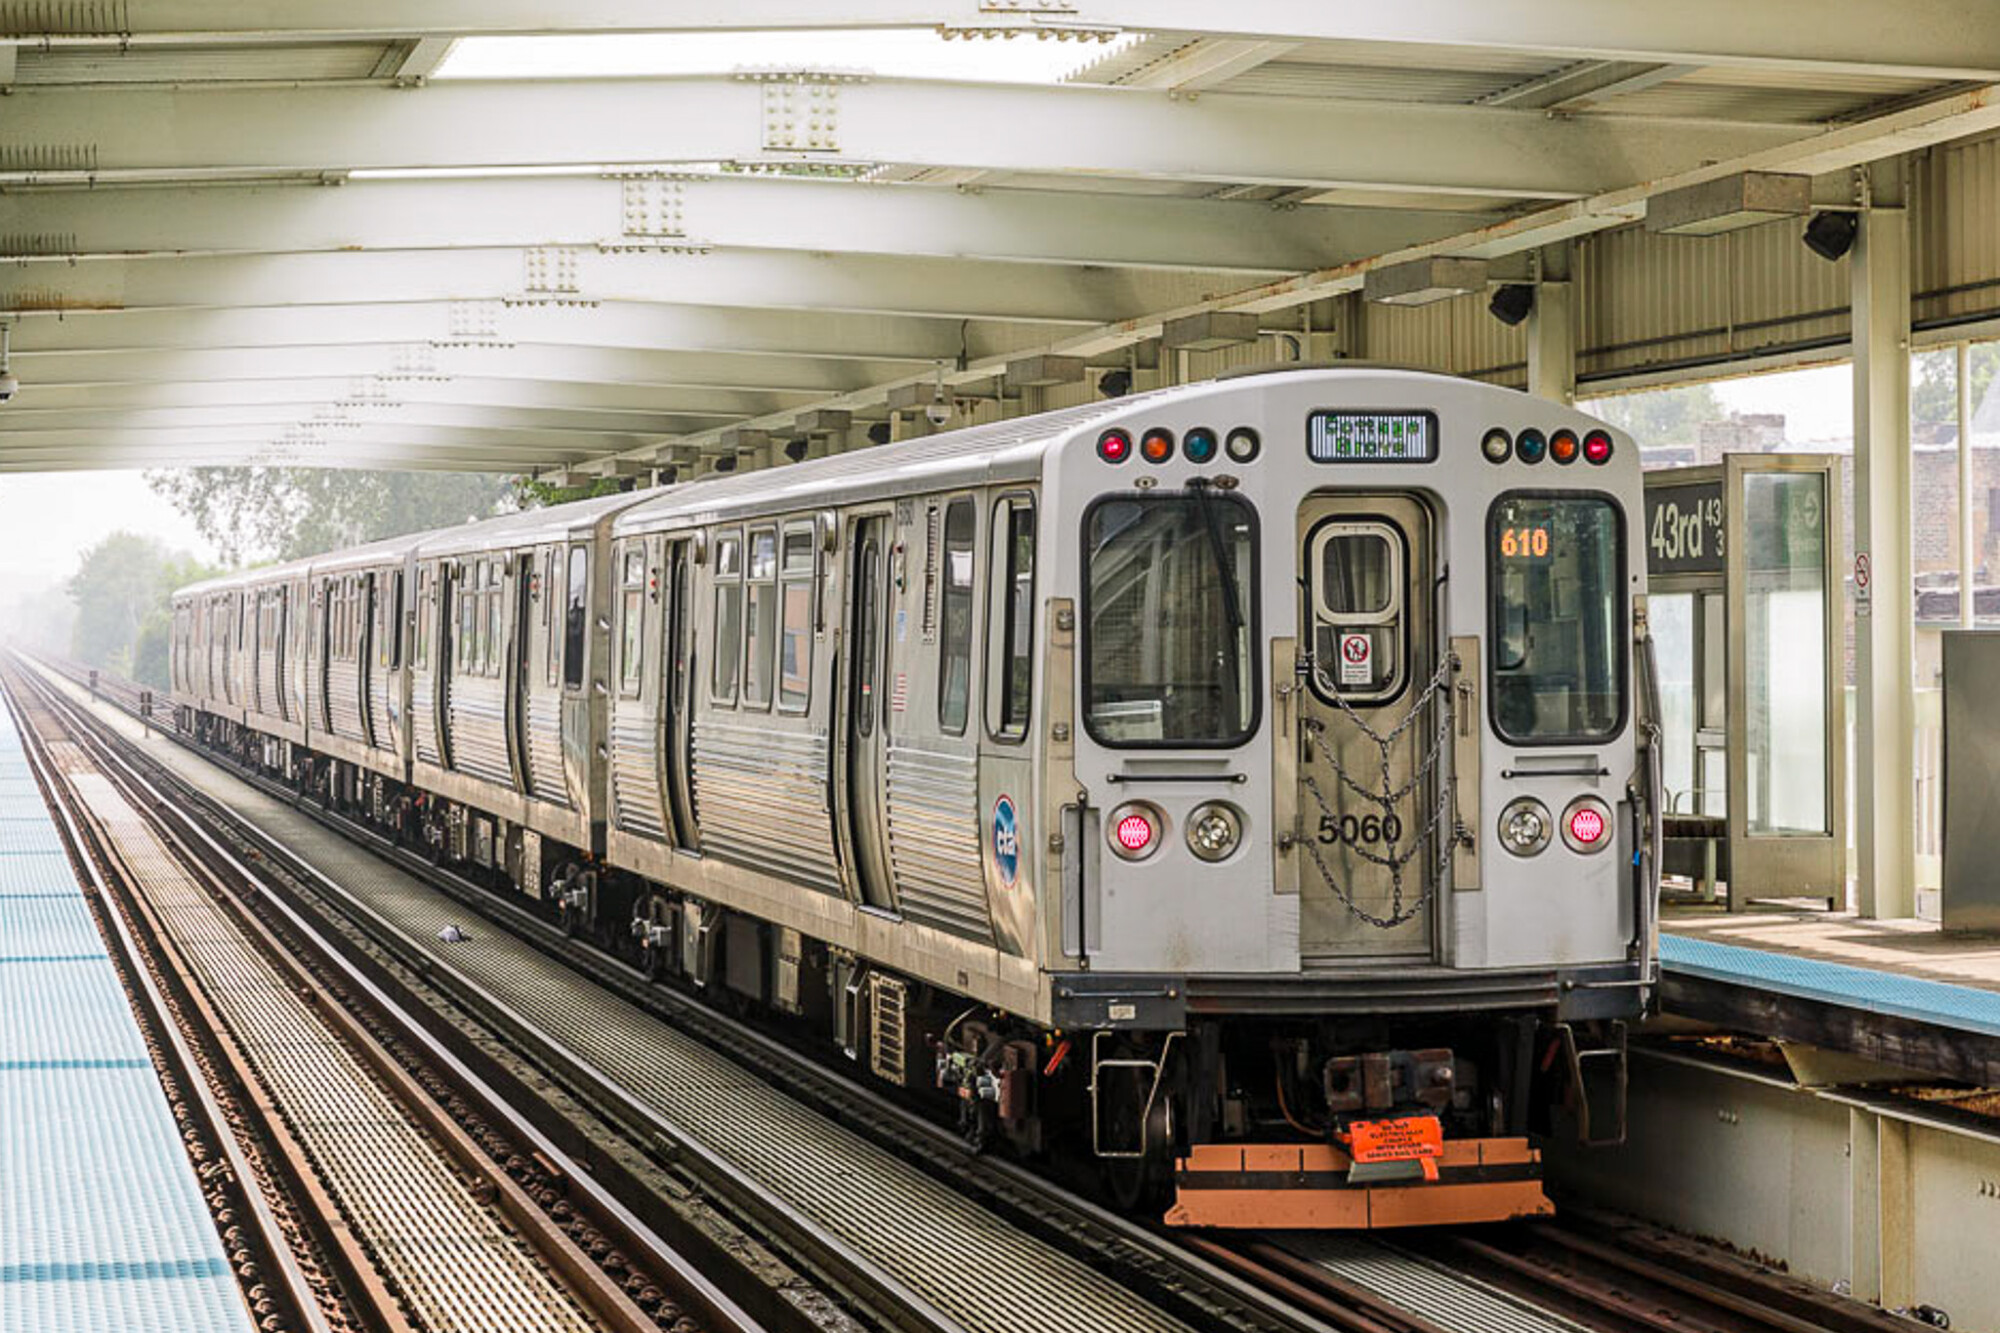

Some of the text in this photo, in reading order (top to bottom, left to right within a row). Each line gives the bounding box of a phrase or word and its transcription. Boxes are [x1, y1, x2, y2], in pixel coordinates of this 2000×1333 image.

[1501, 527, 1548, 557] 610
[1651, 499, 1703, 559] 43rd
[1318, 814, 1402, 844] 5060
